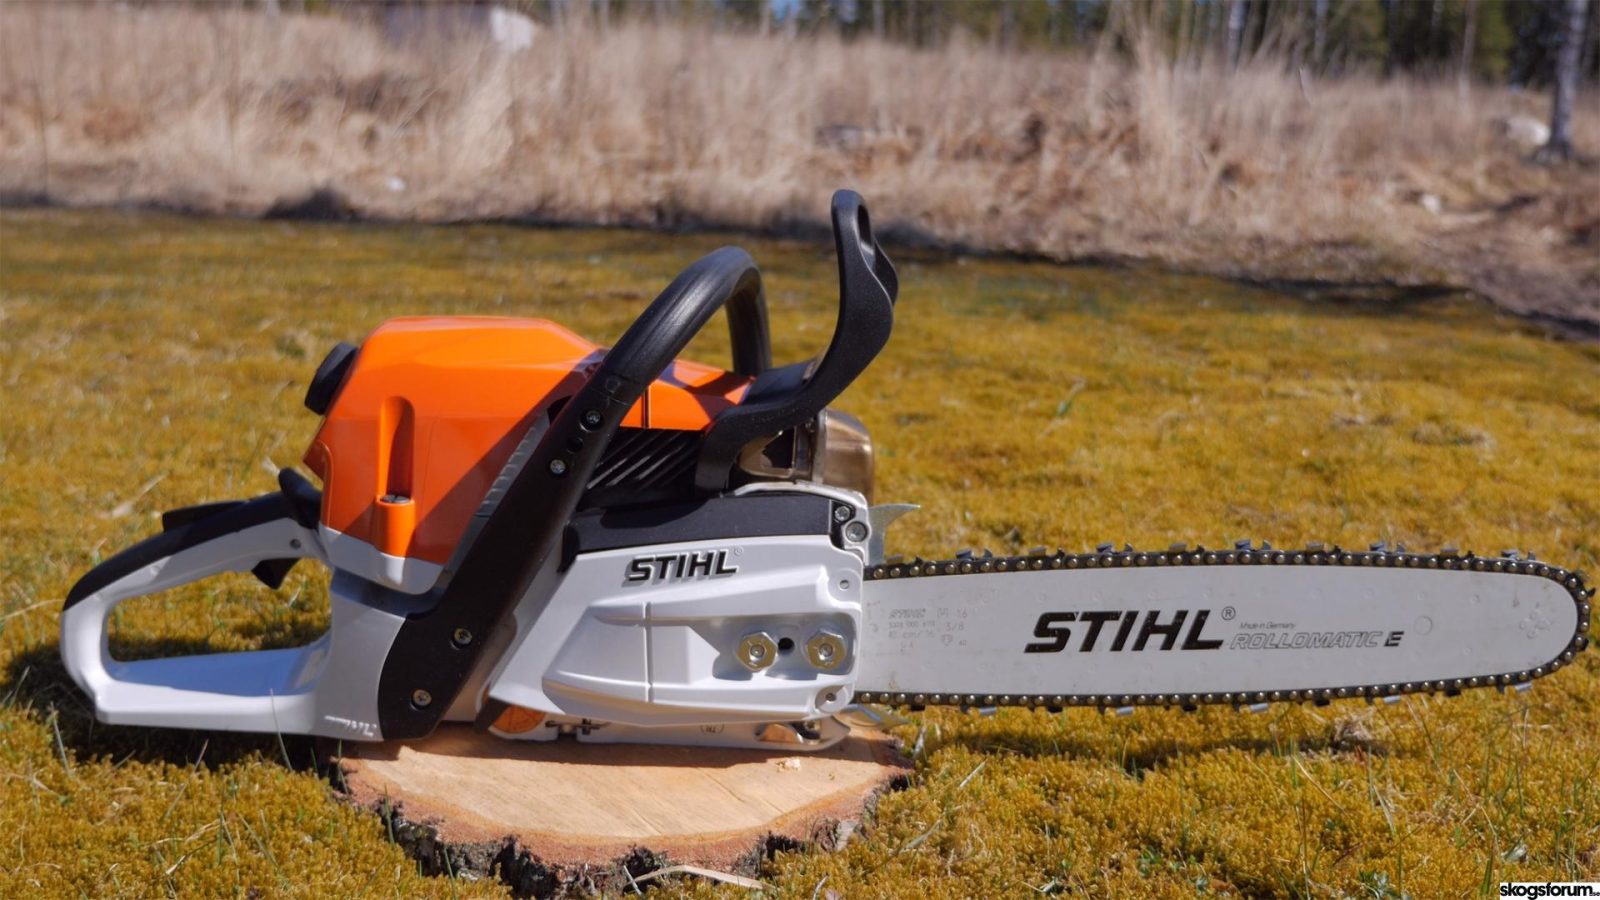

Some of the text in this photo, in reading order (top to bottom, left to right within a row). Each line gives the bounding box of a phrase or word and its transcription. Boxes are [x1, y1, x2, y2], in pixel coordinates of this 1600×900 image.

[624, 549, 739, 585] STIHL
[1024, 609, 1224, 653] STIHL
[1266, 621, 1295, 630] Germany
[1229, 630, 1405, 650] ROLLOMATIC E
